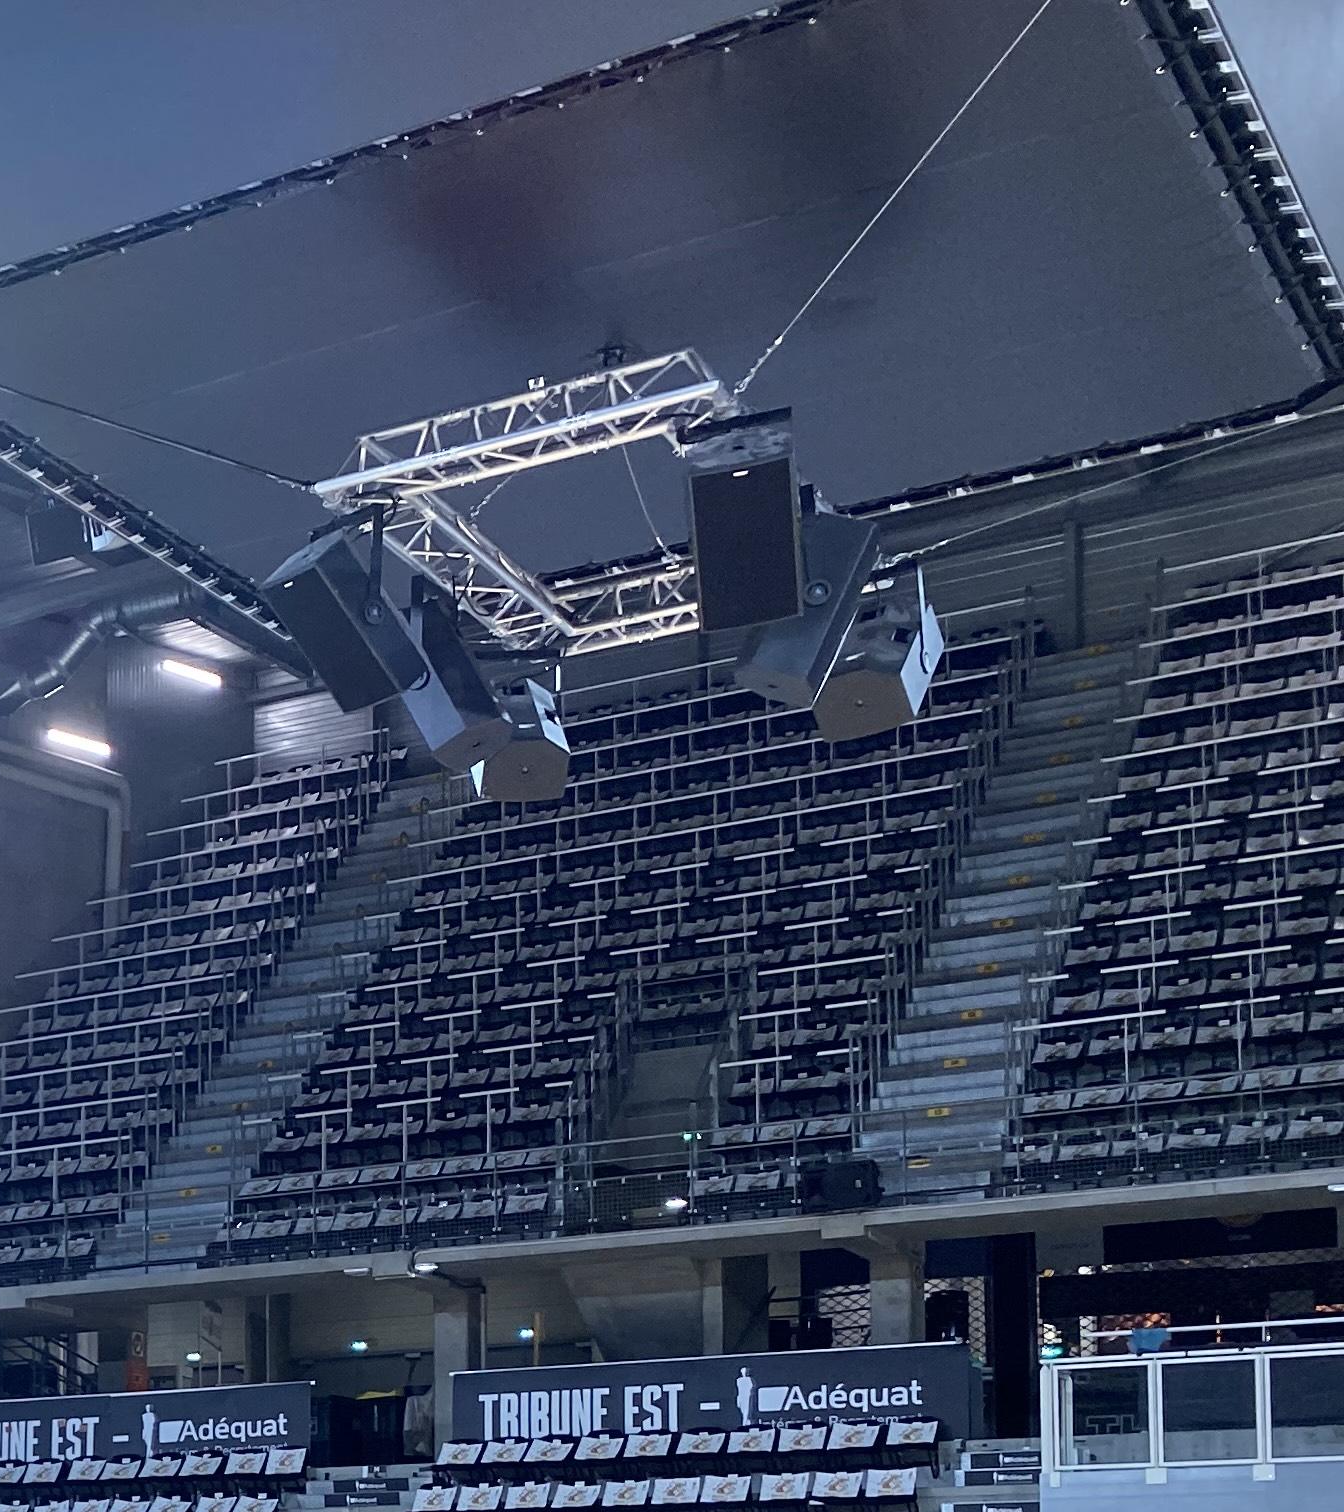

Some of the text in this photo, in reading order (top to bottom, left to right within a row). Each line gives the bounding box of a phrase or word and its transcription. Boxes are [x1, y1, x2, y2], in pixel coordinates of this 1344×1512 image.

[51, 1416, 100, 1460] EST
[179, 1412, 289, 1444] Adéquat
[478, 1387, 610, 1441] TRIBUNE
[624, 1383, 685, 1434] EST
[784, 1379, 924, 1413] Adéquat
